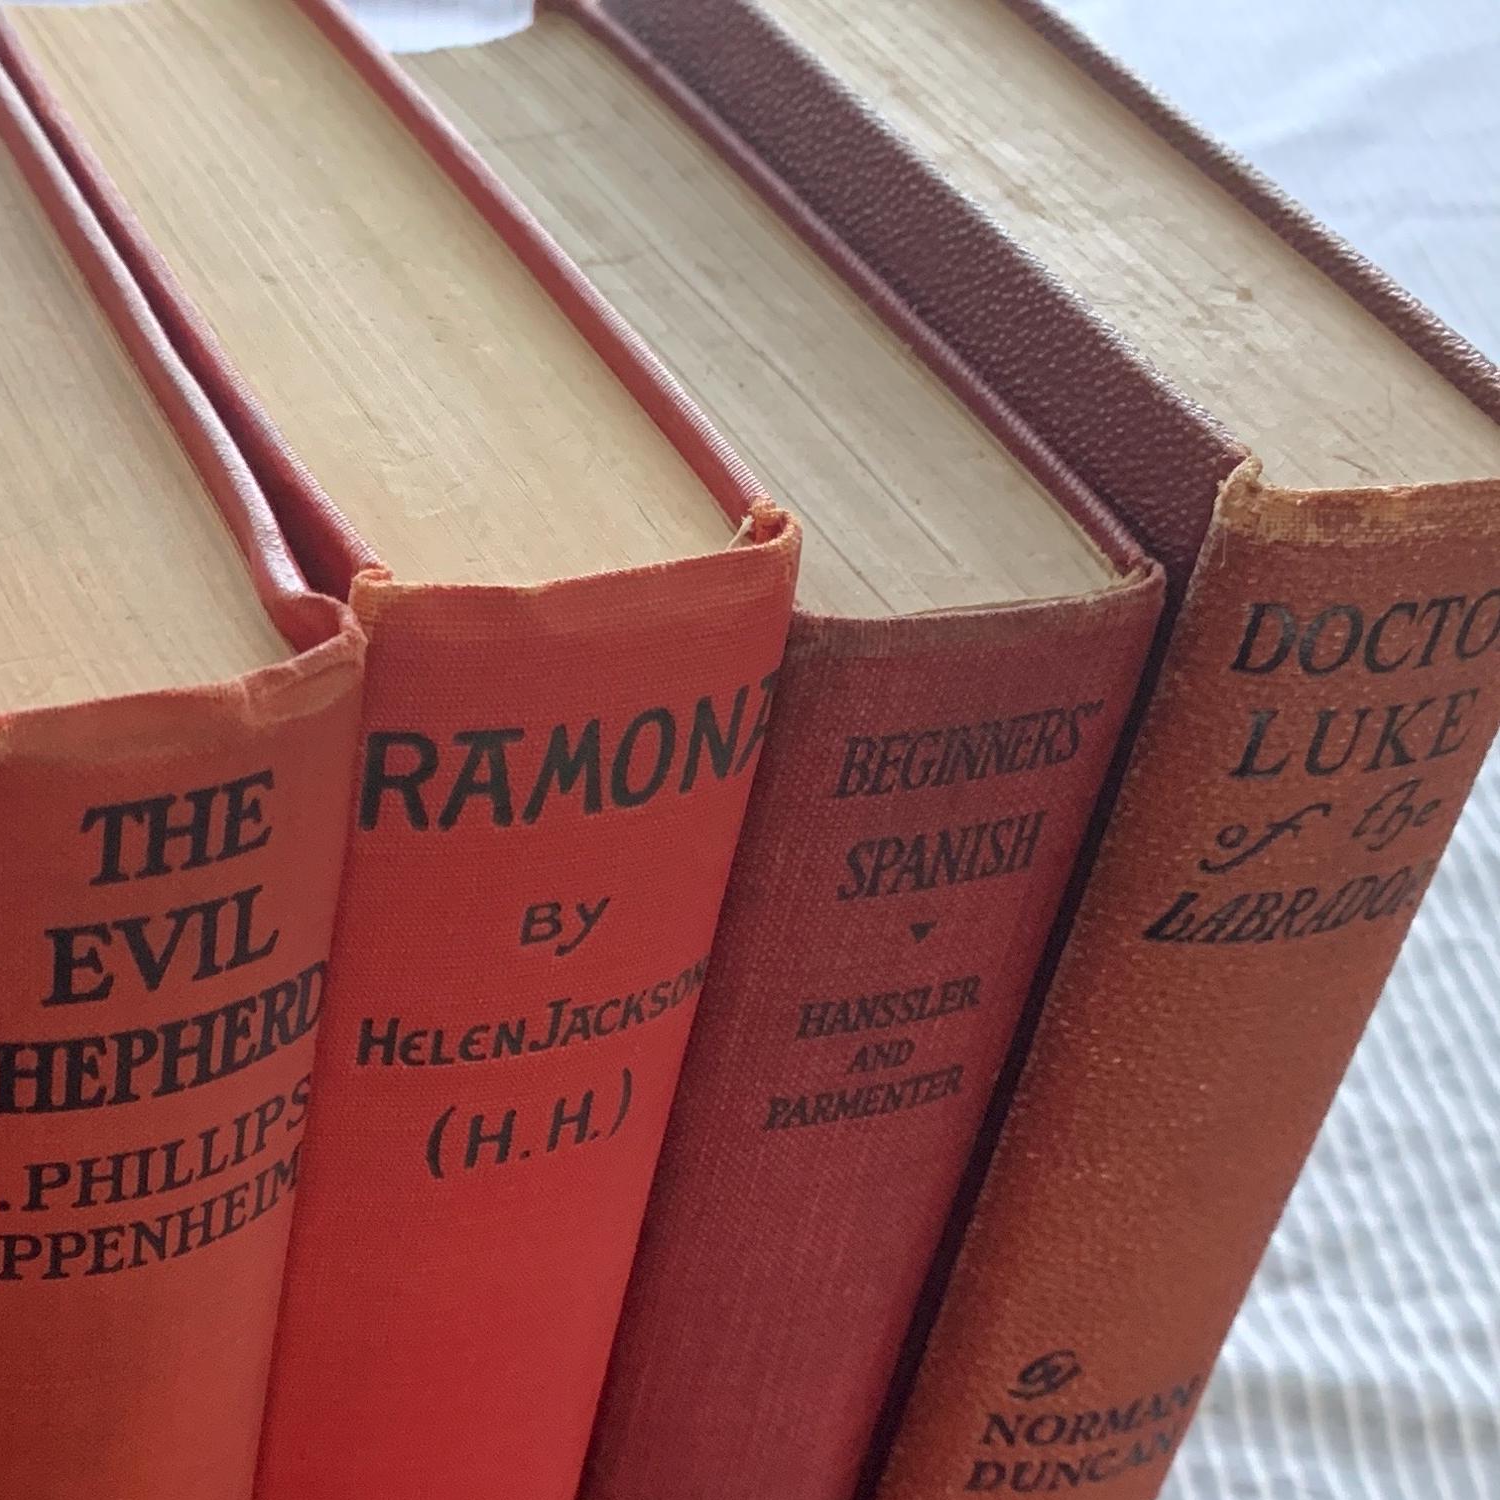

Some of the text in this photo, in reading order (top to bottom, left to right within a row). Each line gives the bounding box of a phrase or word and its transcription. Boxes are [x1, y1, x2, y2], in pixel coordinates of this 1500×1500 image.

[1230, 588, 1500, 676] DOCTO
[1229, 688, 1480, 779] LUKE
[80, 769, 275, 886] THE
[837, 810, 1047, 901] SPANISH
[1200, 778, 1442, 874] of the
[42, 884, 279, 1008] EVIL
[518, 896, 612, 958] By
[794, 974, 981, 1041] HANSSLER
[762, 1064, 964, 1132] PARMENTER
[846, 1039, 915, 1076] AND
